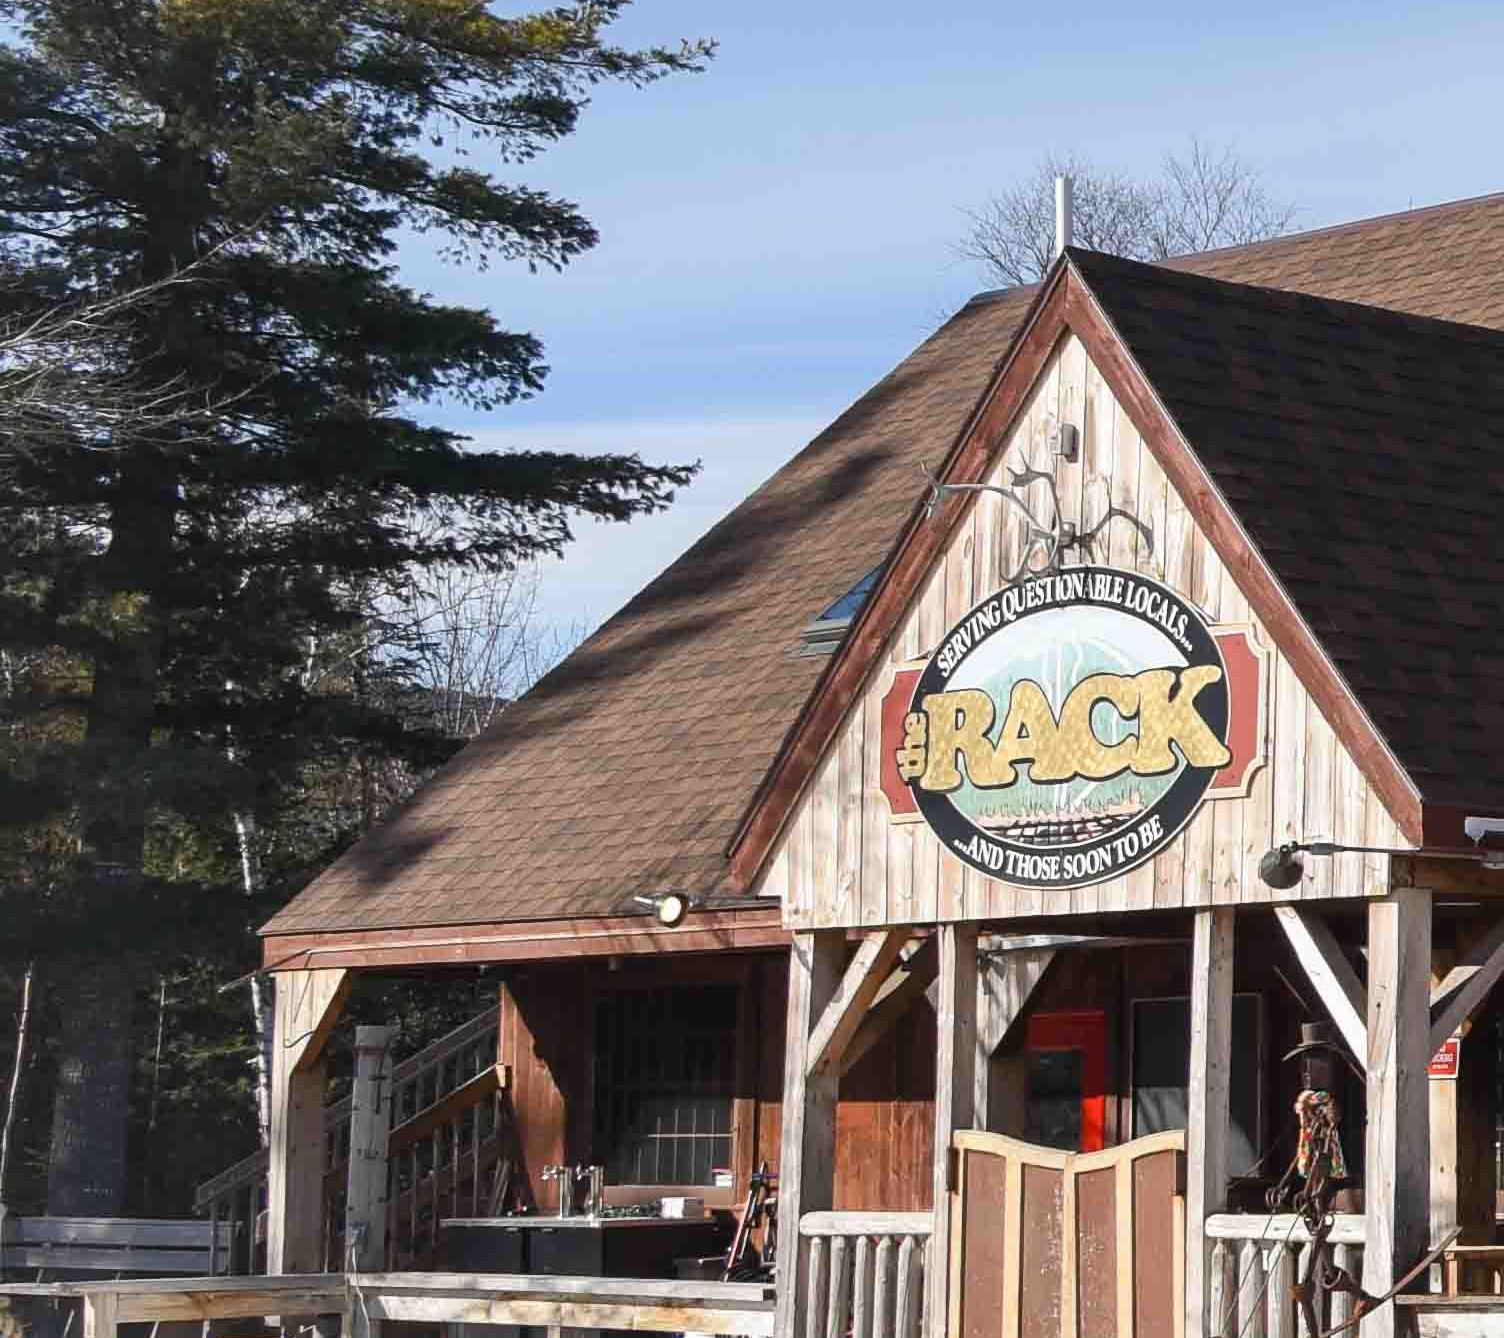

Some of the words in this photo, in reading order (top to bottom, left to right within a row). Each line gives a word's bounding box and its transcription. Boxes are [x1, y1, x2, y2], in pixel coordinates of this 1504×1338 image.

[937, 605, 1000, 677] SERVING
[1001, 574, 1124, 621] QUESTIONABLE
[921, 665, 1232, 791] RACK
[1006, 854, 1061, 880] THOSE
[1063, 847, 1113, 879] SOON
[1114, 833, 1139, 859] TO
[1140, 815, 1164, 848] BE
